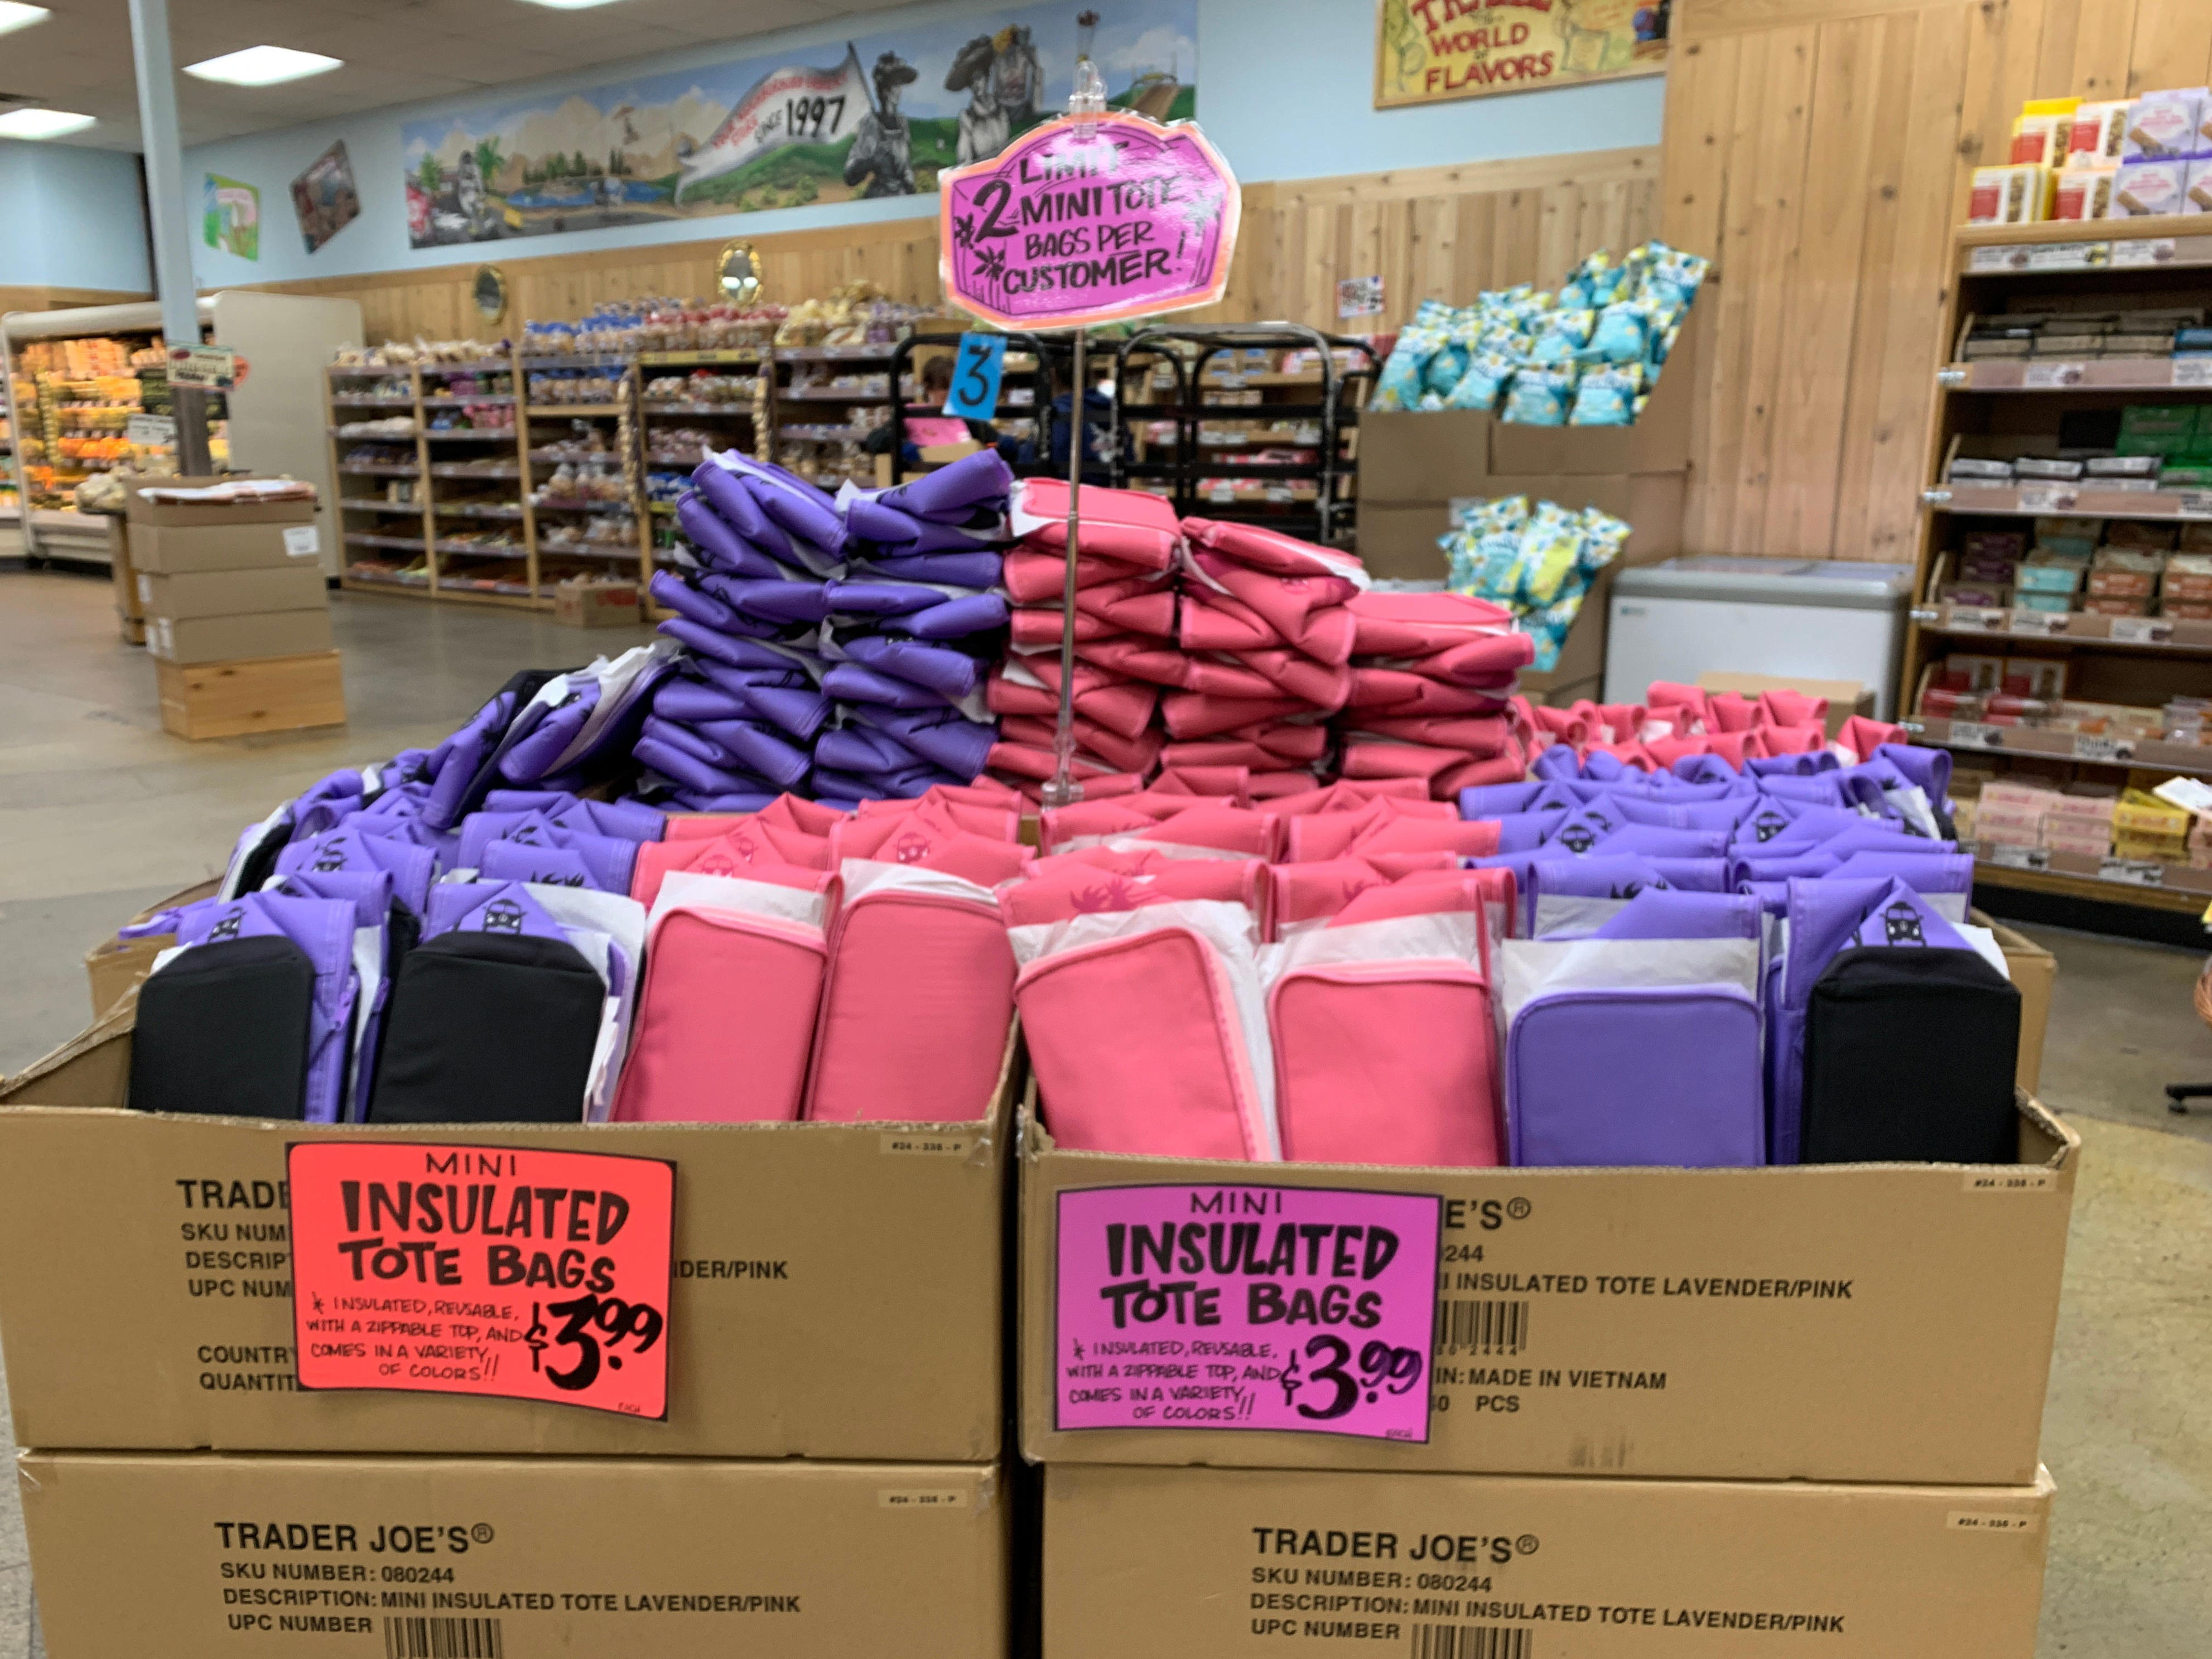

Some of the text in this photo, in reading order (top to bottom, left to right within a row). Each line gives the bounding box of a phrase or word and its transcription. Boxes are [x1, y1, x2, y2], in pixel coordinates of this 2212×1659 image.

[1428, 21, 1530, 56] WORLD
[1425, 50, 1555, 93] FLAVORS
[787, 95, 846, 138] 1997
[972, 176, 1182, 244] 2 MINI TOTE
[1025, 221, 1154, 260] BAGS PER
[958, 345, 994, 406] 3
[425, 1152, 518, 1177] MINI
[340, 1180, 630, 1246] INSULATED
[1190, 1190, 1283, 1215] MINI
[181, 1223, 286, 1242] SKU NUM
[185, 1251, 291, 1270] DESCRIP
[1106, 1221, 1400, 1281] INSULATED
[1444, 1245, 1483, 1262] 244
[338, 1237, 615, 1294] TOTE BAGS
[189, 1279, 292, 1298] UPC NUM
[1457, 1273, 1588, 1293] INSULATED
[1596, 1276, 1656, 1295] TOTE
[1664, 1278, 1855, 1299] LAVENDER/PINK
[1101, 1278, 1382, 1329] TOTE BAGS
[306, 1319, 345, 1333] WITH
[350, 1320, 362, 1333] A
[366, 1320, 442, 1338] ZIPPABLE
[485, 1327, 523, 1343] AND
[310, 1343, 489, 1363] COMES IN A VARIETY
[200, 1372, 297, 1392] QUANTIT
[378, 1363, 402, 1376] OF
[1066, 1364, 1103, 1378] WITH
[1108, 1364, 1119, 1378] A
[1123, 1363, 1198, 1379] ZIPPABLE
[1242, 1365, 1281, 1381] AND
[1435, 1367, 1667, 1390] IN: MADE IN VIETNAM
[1068, 1385, 1246, 1404] COMES IN A VARIETY
[1476, 1395, 1520, 1413] PCS
[1132, 1406, 1155, 1419] OF
[214, 1522, 358, 1552] TRADER
[1252, 1527, 1399, 1559] TRADER
[221, 1562, 455, 1584] SKU NUMBER: 080244
[1251, 1567, 1493, 1593] SKU NUMBER: 080244
[224, 1588, 801, 1613] DESCRIPTION: MINI INSULATED TOTE LAVENDER/PINK
[228, 1614, 373, 1634] UPC NUMBER
[1250, 1593, 1845, 1634] DESCRIPTION: MINI INSULATED TOTE LAVENDER/PINK
[1251, 1619, 1401, 1641] UPC NUMBER
